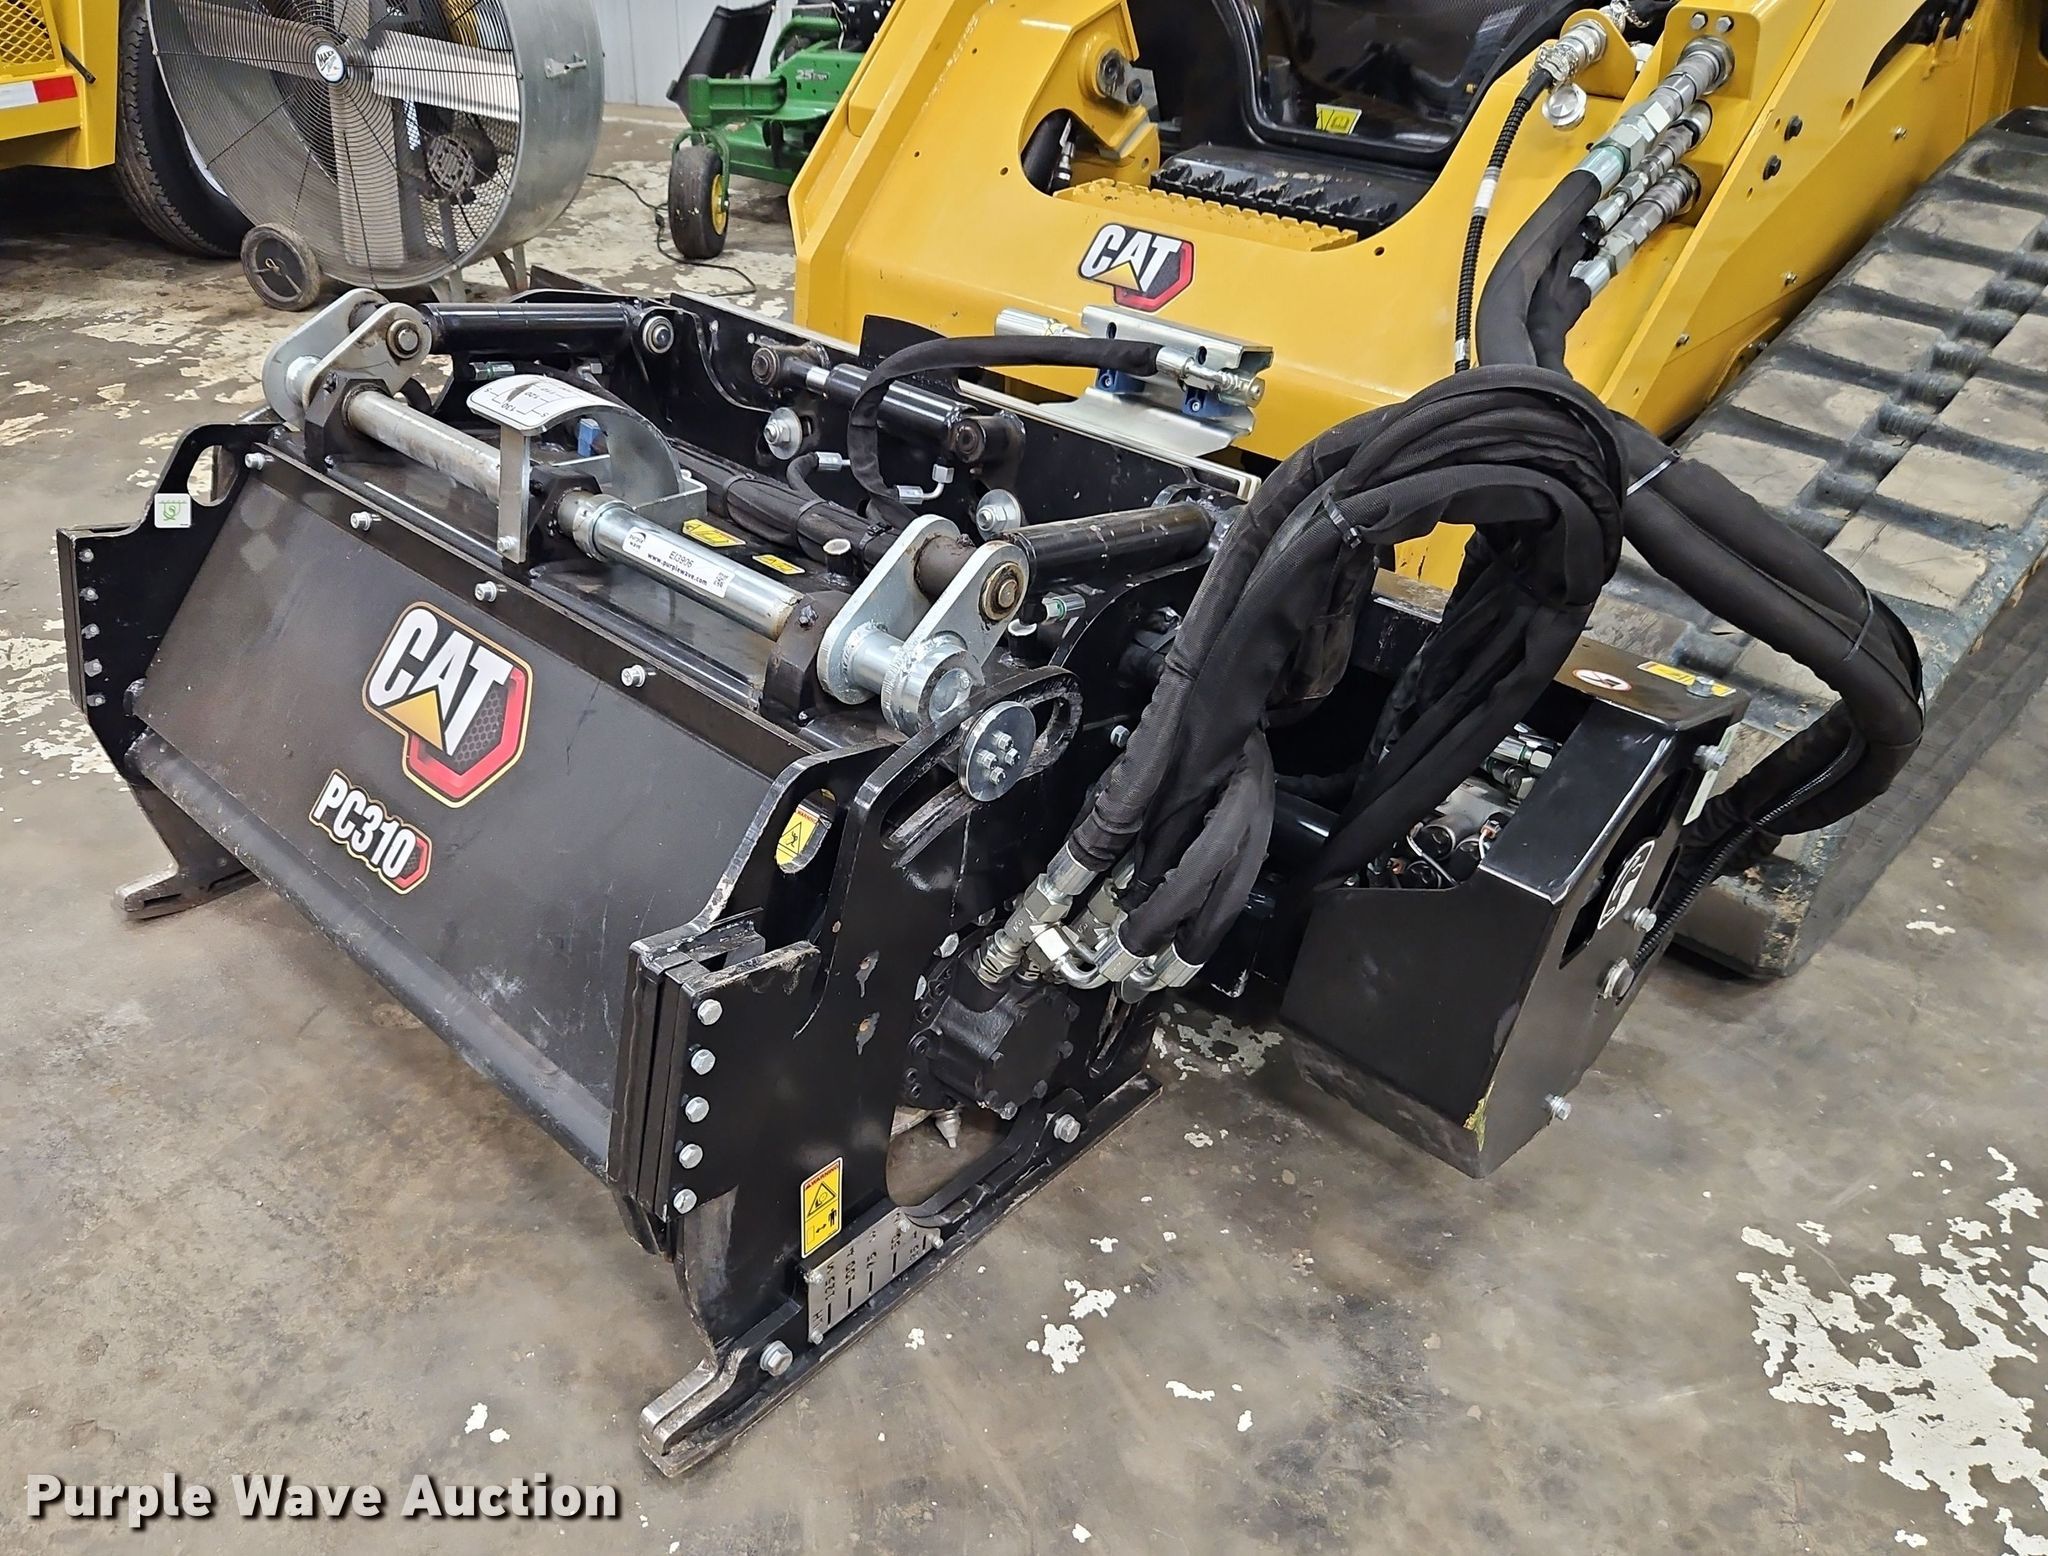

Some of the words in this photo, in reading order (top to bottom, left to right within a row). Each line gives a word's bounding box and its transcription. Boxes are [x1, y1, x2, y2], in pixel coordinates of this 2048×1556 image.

[1080, 224, 1183, 293] CAT
[501, 403, 517, 412] 130
[647, 552, 708, 587] www.purplewave.com
[369, 608, 514, 757] CAT
[313, 773, 416, 879] PC310
[810, 1164, 840, 1187] WARNING
[845, 1260, 856, 1286] 100
[866, 1251, 878, 1270] 75
[824, 1275, 836, 1301] 125
